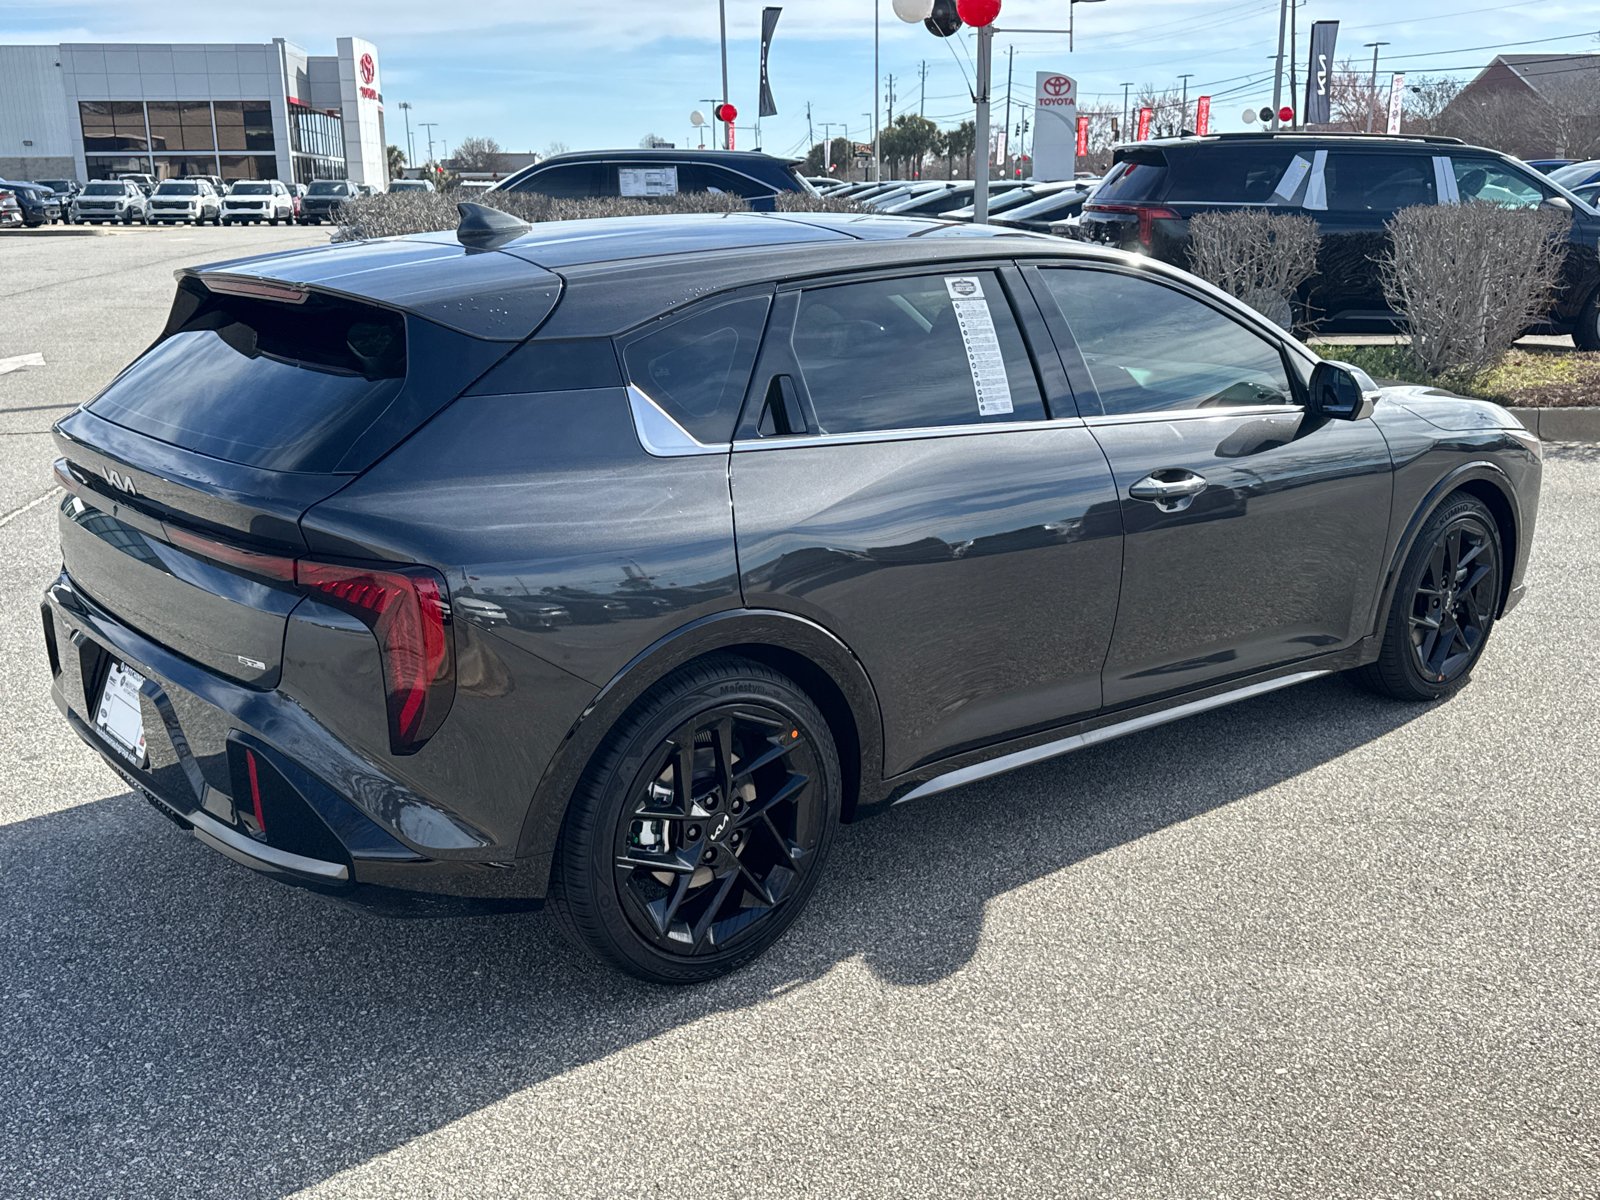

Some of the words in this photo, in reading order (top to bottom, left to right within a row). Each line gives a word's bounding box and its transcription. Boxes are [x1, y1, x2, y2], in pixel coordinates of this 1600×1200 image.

[1038, 97, 1075, 106] TOYOTA
[102, 466, 136, 496] KIA
[1440, 504, 1468, 525] KUMHO
[710, 814, 729, 840] KIA
